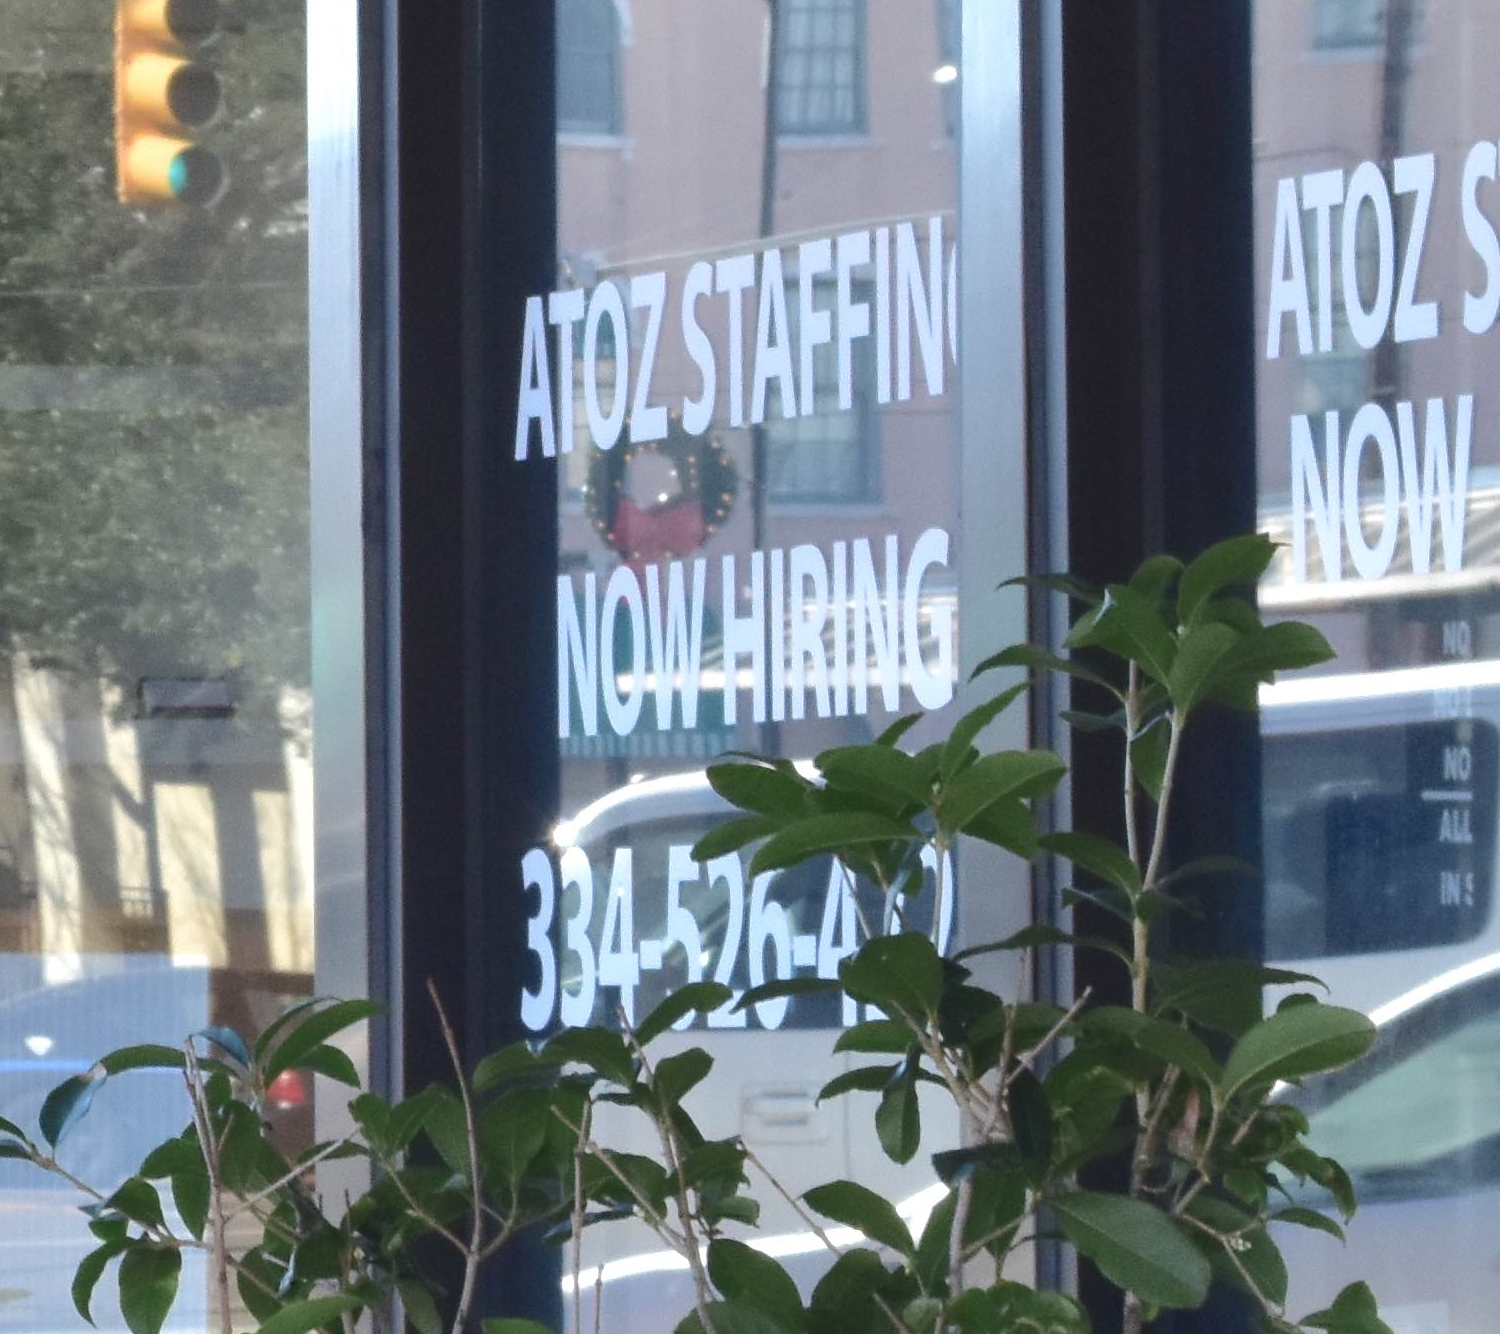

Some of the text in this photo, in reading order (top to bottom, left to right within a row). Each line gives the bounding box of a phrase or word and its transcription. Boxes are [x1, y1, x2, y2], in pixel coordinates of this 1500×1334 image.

[1265, 138, 1500, 360] ATOZ S
[513, 270, 669, 462] ATOZ
[1289, 393, 1474, 584] NOW
[557, 527, 955, 740] NOW HIRING
[519, 844, 954, 1032] 334-526-4
